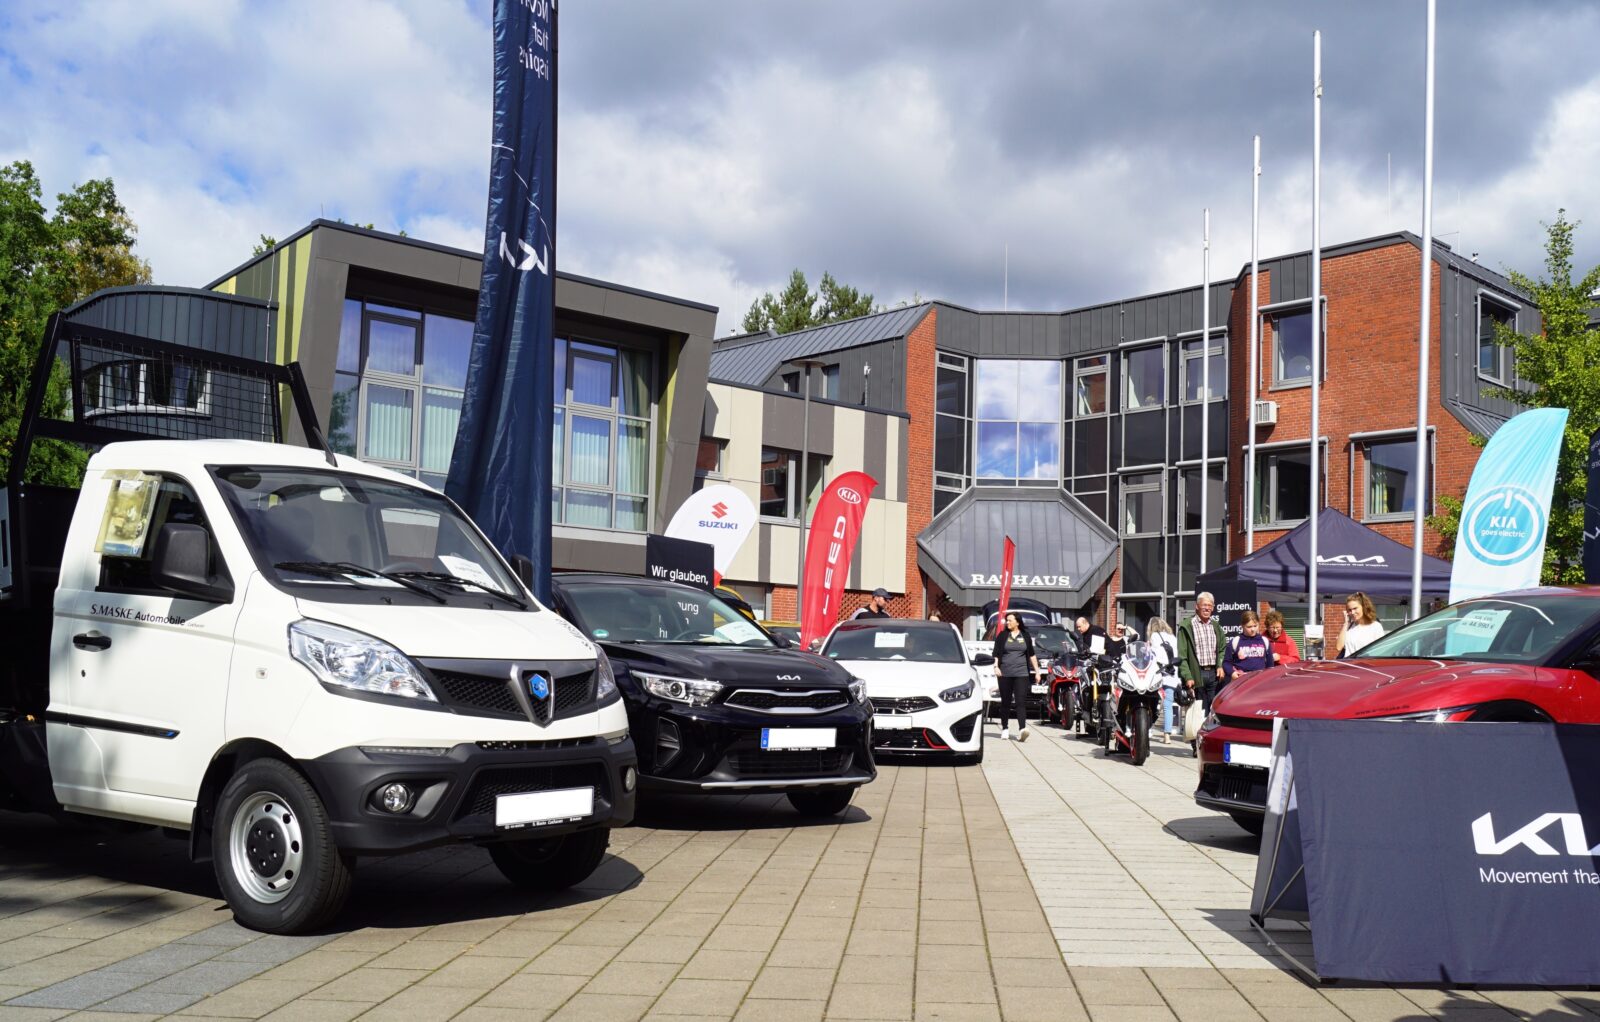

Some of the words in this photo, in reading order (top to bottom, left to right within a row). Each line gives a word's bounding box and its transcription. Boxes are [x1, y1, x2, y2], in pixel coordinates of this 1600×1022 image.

[841, 488, 857, 502] KIA
[698, 520, 739, 530] SUZUKI
[1490, 516, 1518, 529] KIA
[1499, 530, 1526, 538] electric
[651, 564, 668, 578] Wir
[669, 568, 709, 586] glauben,
[969, 573, 1071, 587] RAHAUS
[1216, 601, 1252, 613] glauben,
[134, 611, 186, 627] Automobile
[1479, 867, 1569, 884] Movement
